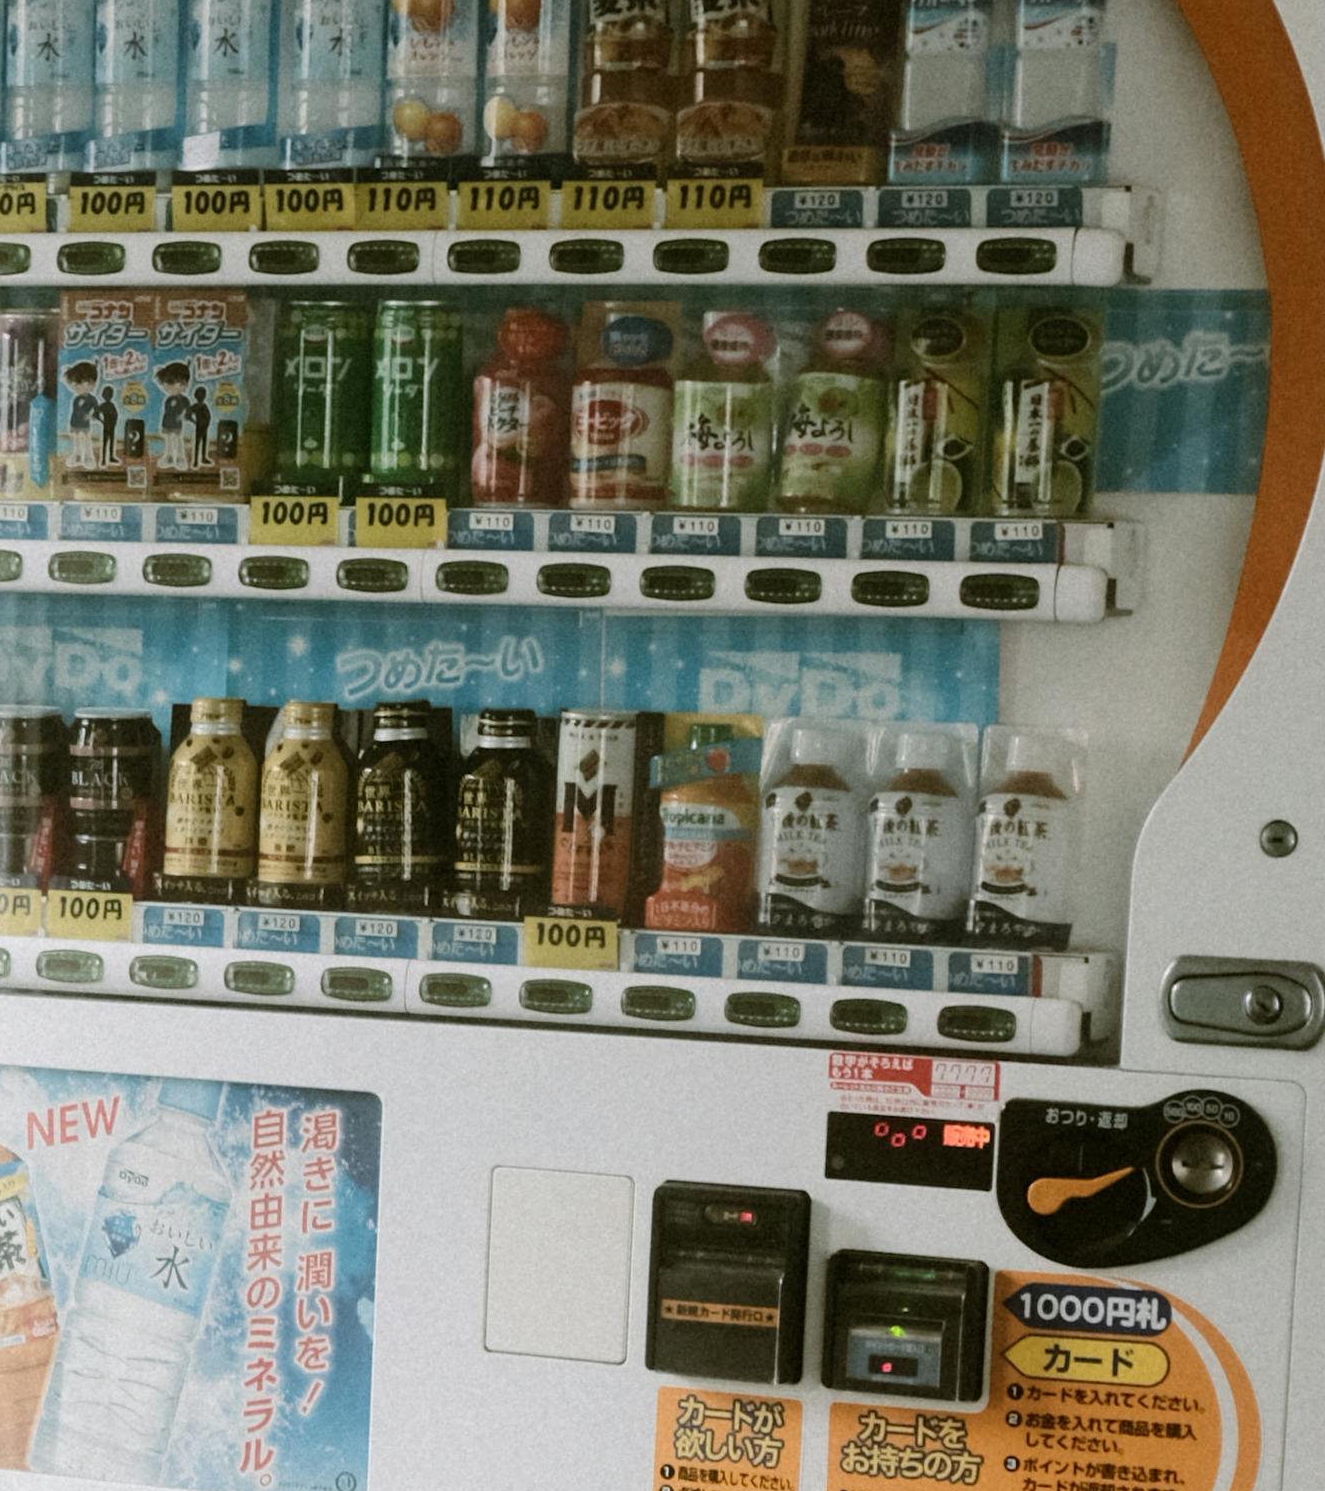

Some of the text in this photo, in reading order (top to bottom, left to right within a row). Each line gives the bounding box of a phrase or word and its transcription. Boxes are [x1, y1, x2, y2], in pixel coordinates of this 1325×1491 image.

[210, 15, 242, 27] いしい
[36, 32, 60, 62] 水
[123, 31, 147, 60] 水
[213, 28, 238, 58] 水
[81, 191, 145, 215] 100円
[184, 190, 249, 214] 100円
[276, 188, 344, 213] 100円
[368, 187, 436, 211] 110円
[470, 186, 539, 211] 110円
[574, 185, 645, 210] 110円
[679, 184, 752, 209] 110円
[798, 193, 836, 206] ¥120
[906, 193, 944, 206] ¥120
[1014, 192, 1053, 205] ¥120
[65, 321, 150, 348] サイダー
[158, 321, 243, 348] サイダー
[84, 507, 118, 519] ¥110
[262, 501, 329, 525] 100円
[367, 502, 435, 527] 100円
[474, 516, 511, 528] ¥110
[576, 518, 612, 530] ¥110
[678, 520, 715, 532] ¥110
[785, 521, 822, 533] ¥110
[890, 523, 929, 535] ¥110
[1000, 526, 1040, 538] ¥110
[698, 651, 902, 719] DyDo
[71, 770, 131, 788] BLACK
[358, 800, 429, 813] BARISA
[458, 806, 523, 820] ARISA
[777, 812, 840, 831] 後の紅茶
[880, 817, 940, 836] 後の紅茶
[986, 819, 1049, 840] 後の紅茶
[59, 895, 123, 922] 100円
[168, 912, 201, 925] ¥120
[263, 916, 296, 930] ¥120
[359, 922, 394, 935] ¥120
[458, 927, 493, 940] ¥120
[537, 922, 606, 949] 100円
[661, 939, 698, 952] ¥110
[762, 945, 799, 959] ¥110
[869, 951, 907, 965] ¥110
[976, 959, 1015, 972] ¥110
[832, 1052, 914, 1071] 数字がそろえば
[26, 1095, 121, 1151] NEW
[1045, 1107, 1129, 1131] おつり・返却
[118, 1168, 150, 1188] DyDo
[301, 1111, 338, 1235] 渇きに
[149, 1218, 213, 1251] おいしい
[149, 1244, 190, 1291] 水
[239, 1109, 286, 1487] 自然由来のミネラル。
[1019, 1291, 1167, 1332] 1000円札
[1043, 1343, 1135, 1378] カード
[1027, 1384, 1206, 1415] カードを入れてください。
[677, 1394, 785, 1437] カードが
[1025, 1412, 1197, 1442] お金を入れて商品を購入
[857, 1409, 968, 1450] カードを
[674, 1428, 785, 1470] 欲しい方
[1025, 1431, 1125, 1456] してください。
[840, 1443, 984, 1486] お持ちの方
[1023, 1458, 1186, 1486] ポイントが書き込まれ、
